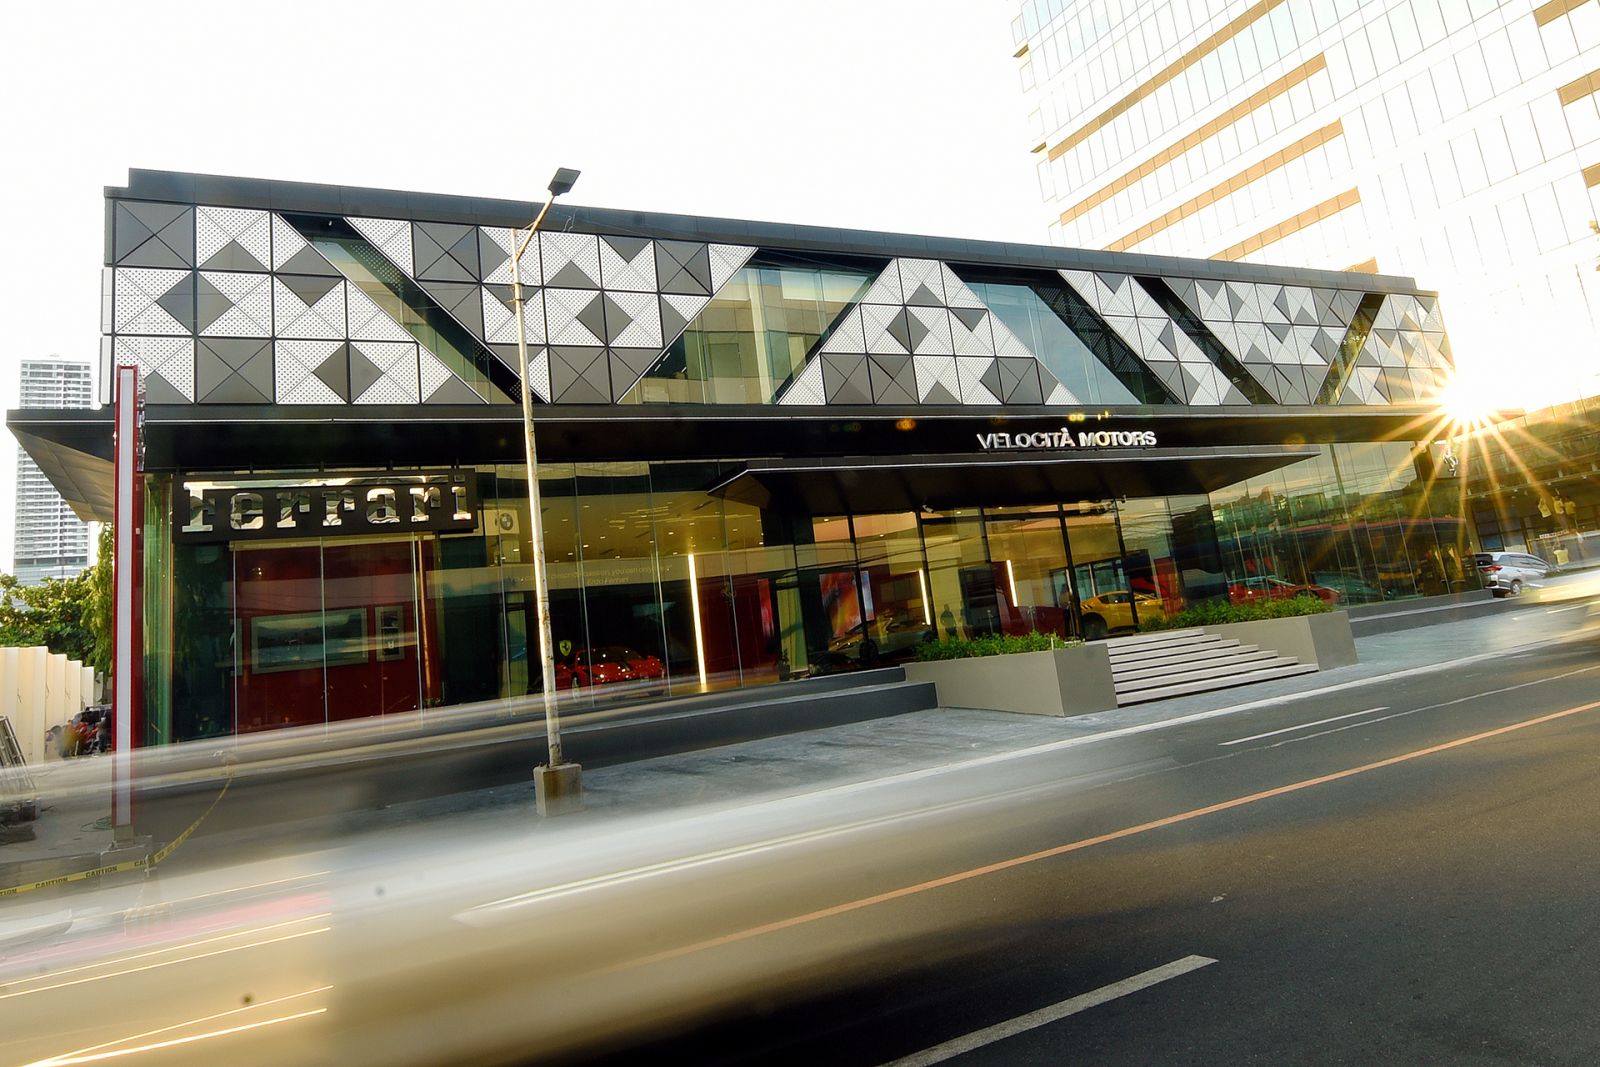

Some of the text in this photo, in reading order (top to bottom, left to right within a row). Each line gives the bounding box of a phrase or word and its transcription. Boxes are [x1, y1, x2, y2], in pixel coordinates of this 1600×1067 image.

[976, 427, 1157, 449] VELOCITÀ MOTORS
[182, 474, 472, 533] Ferrari
[0, 865, 118, 896] TION CAUTION CAUTION
